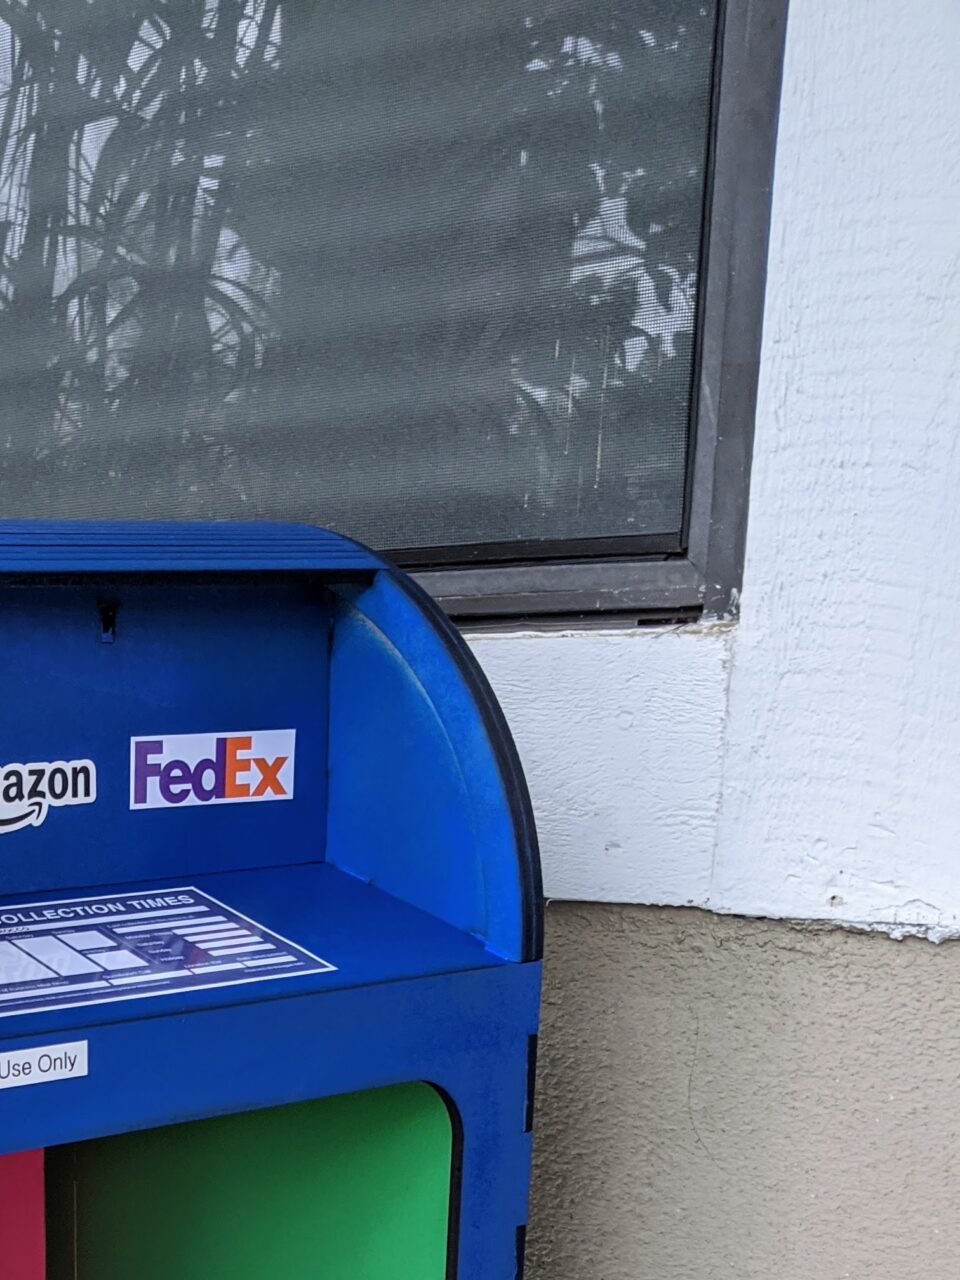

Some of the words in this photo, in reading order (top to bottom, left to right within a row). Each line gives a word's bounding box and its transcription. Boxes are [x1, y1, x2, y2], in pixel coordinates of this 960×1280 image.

[134, 736, 288, 804] FedEx
[127, 894, 195, 911] TIMES
[37, 1050, 78, 1080] Only
